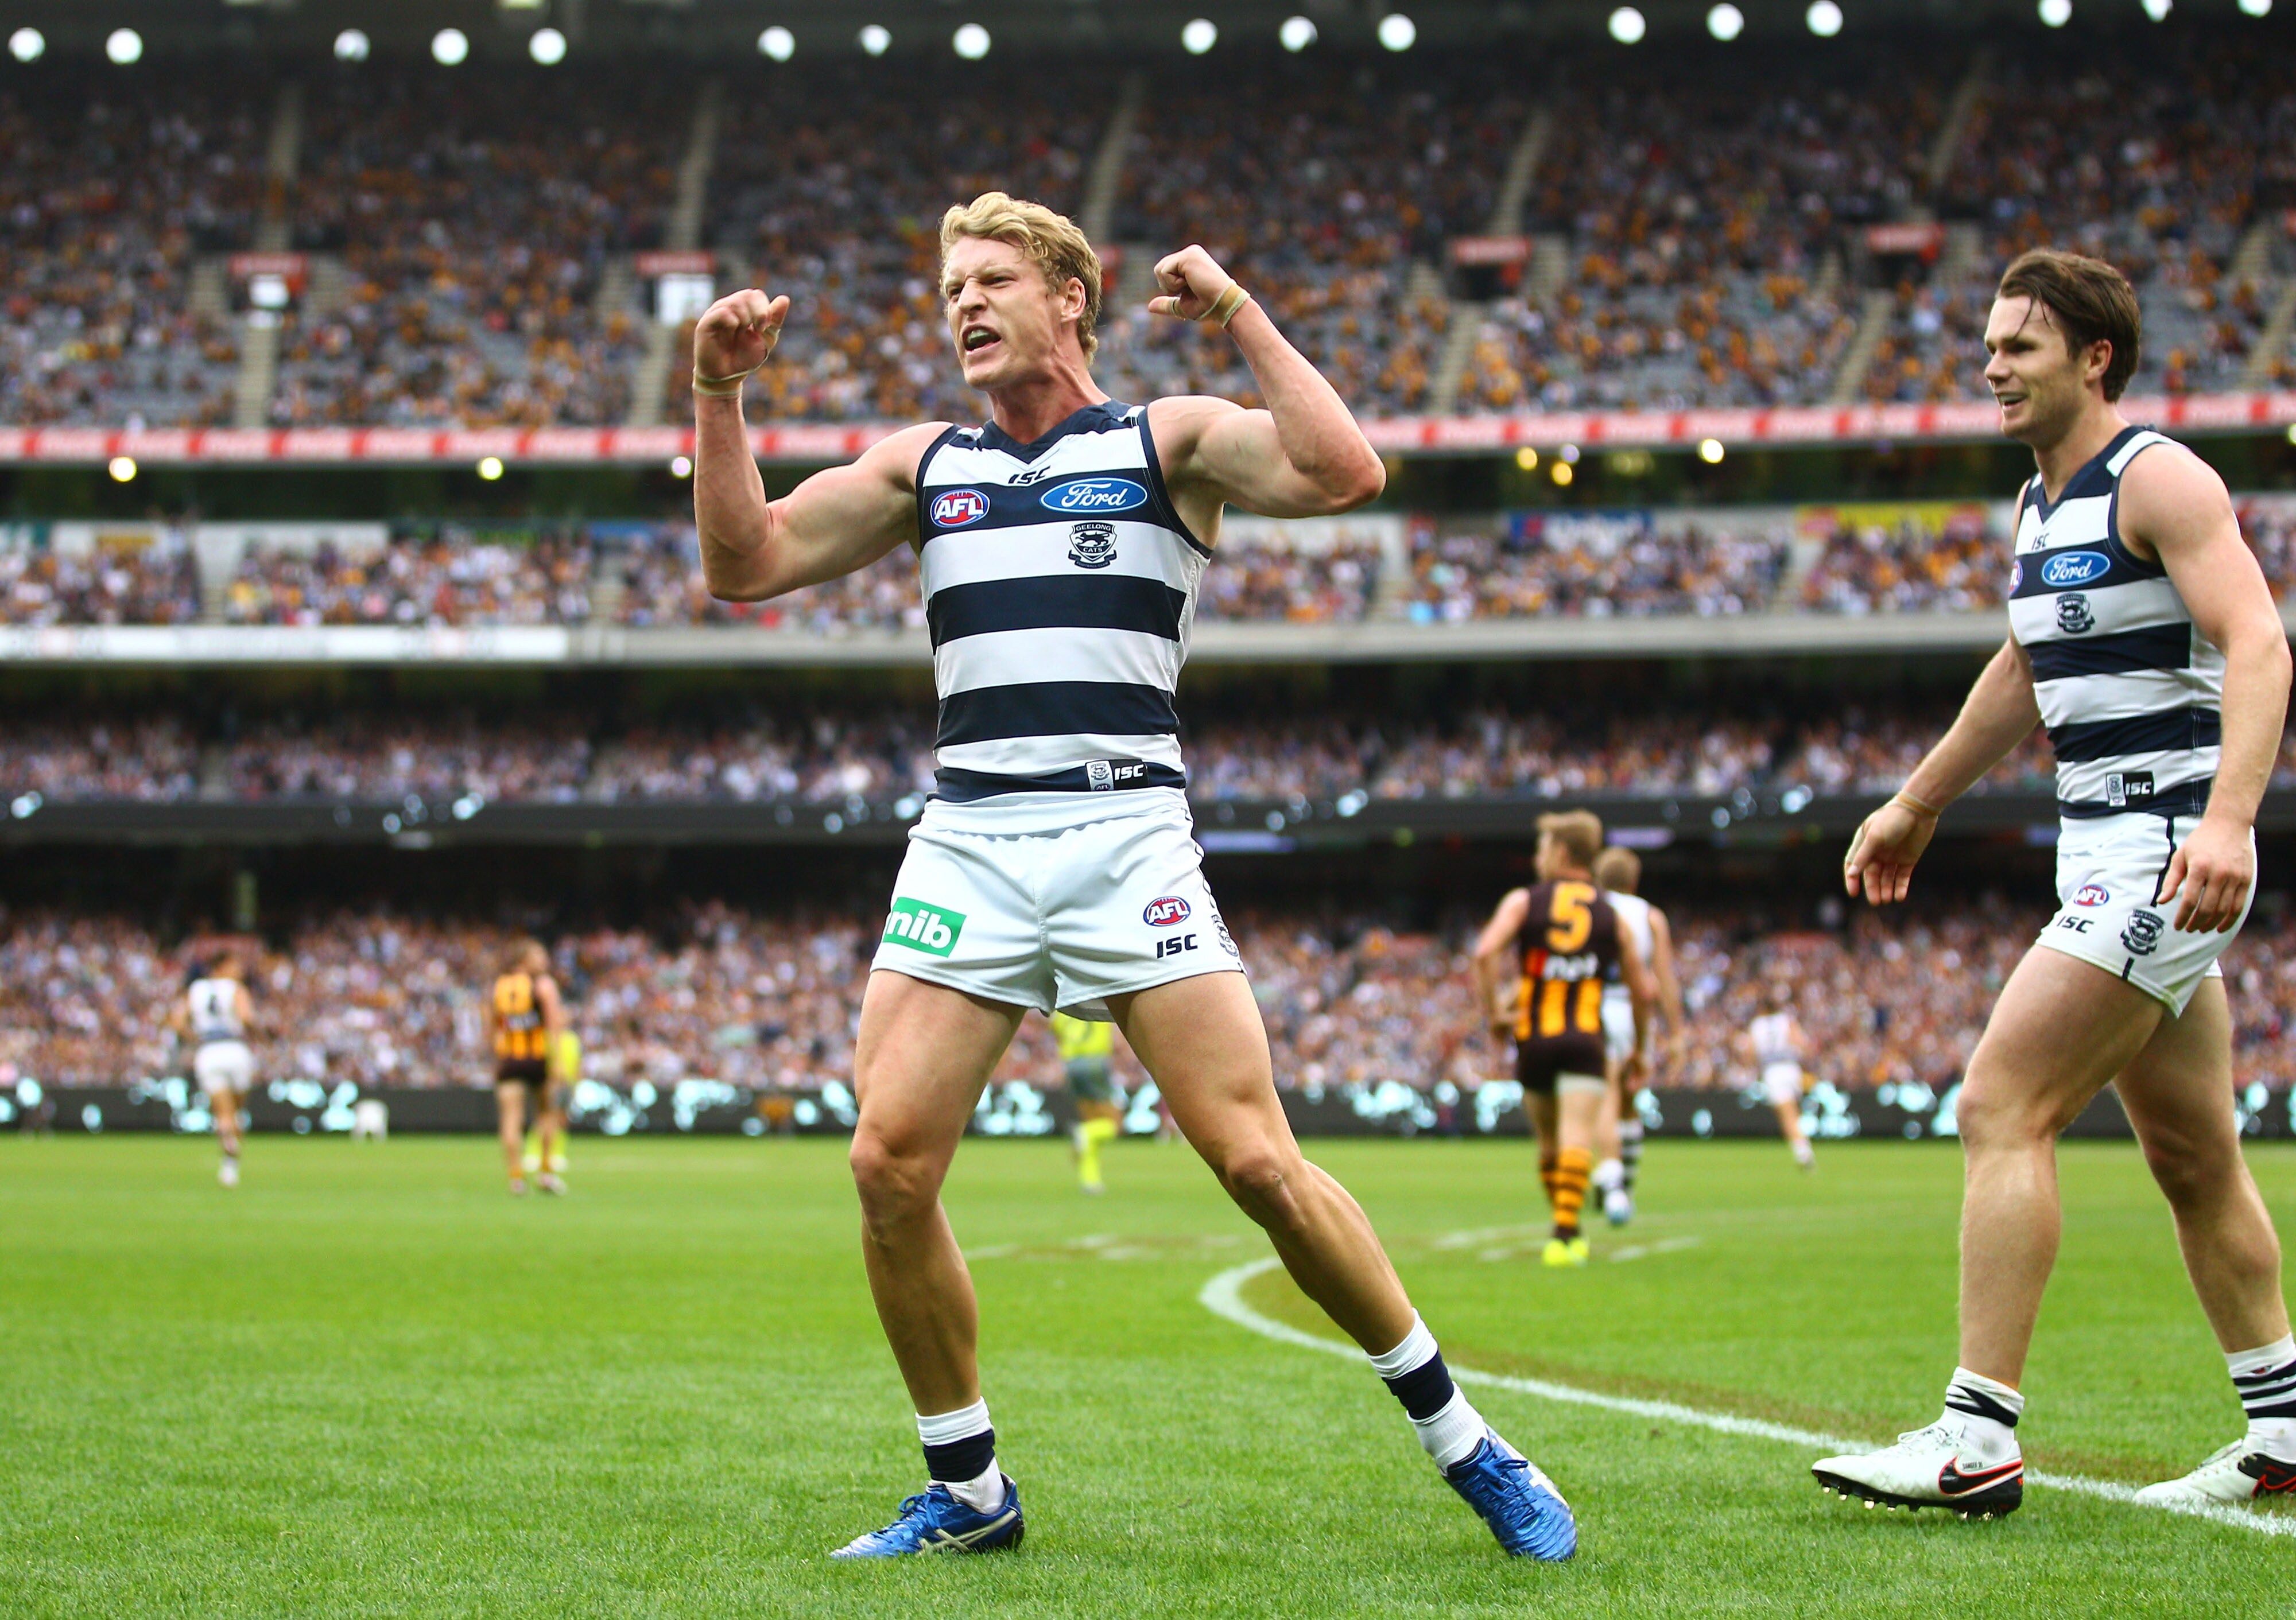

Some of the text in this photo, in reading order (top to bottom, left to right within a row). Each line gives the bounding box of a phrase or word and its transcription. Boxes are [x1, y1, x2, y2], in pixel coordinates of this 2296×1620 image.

[1008, 465, 1050, 484] ISC
[1061, 482, 1128, 508] Ford
[934, 497, 984, 520] AFL
[1076, 523, 1111, 531] GEELONG
[2032, 533, 2050, 550] ISC
[2049, 555, 2093, 581] Ford
[1114, 764, 1144, 781] ISC
[2126, 781, 2152, 795] ISC
[2076, 888, 2107, 903] AFL
[1148, 900, 1190, 924] AFL
[1545, 881, 1597, 954] 5
[886, 908, 953, 949] nib
[2057, 915, 2094, 934] ISC
[1157, 933, 1198, 959] ISC
